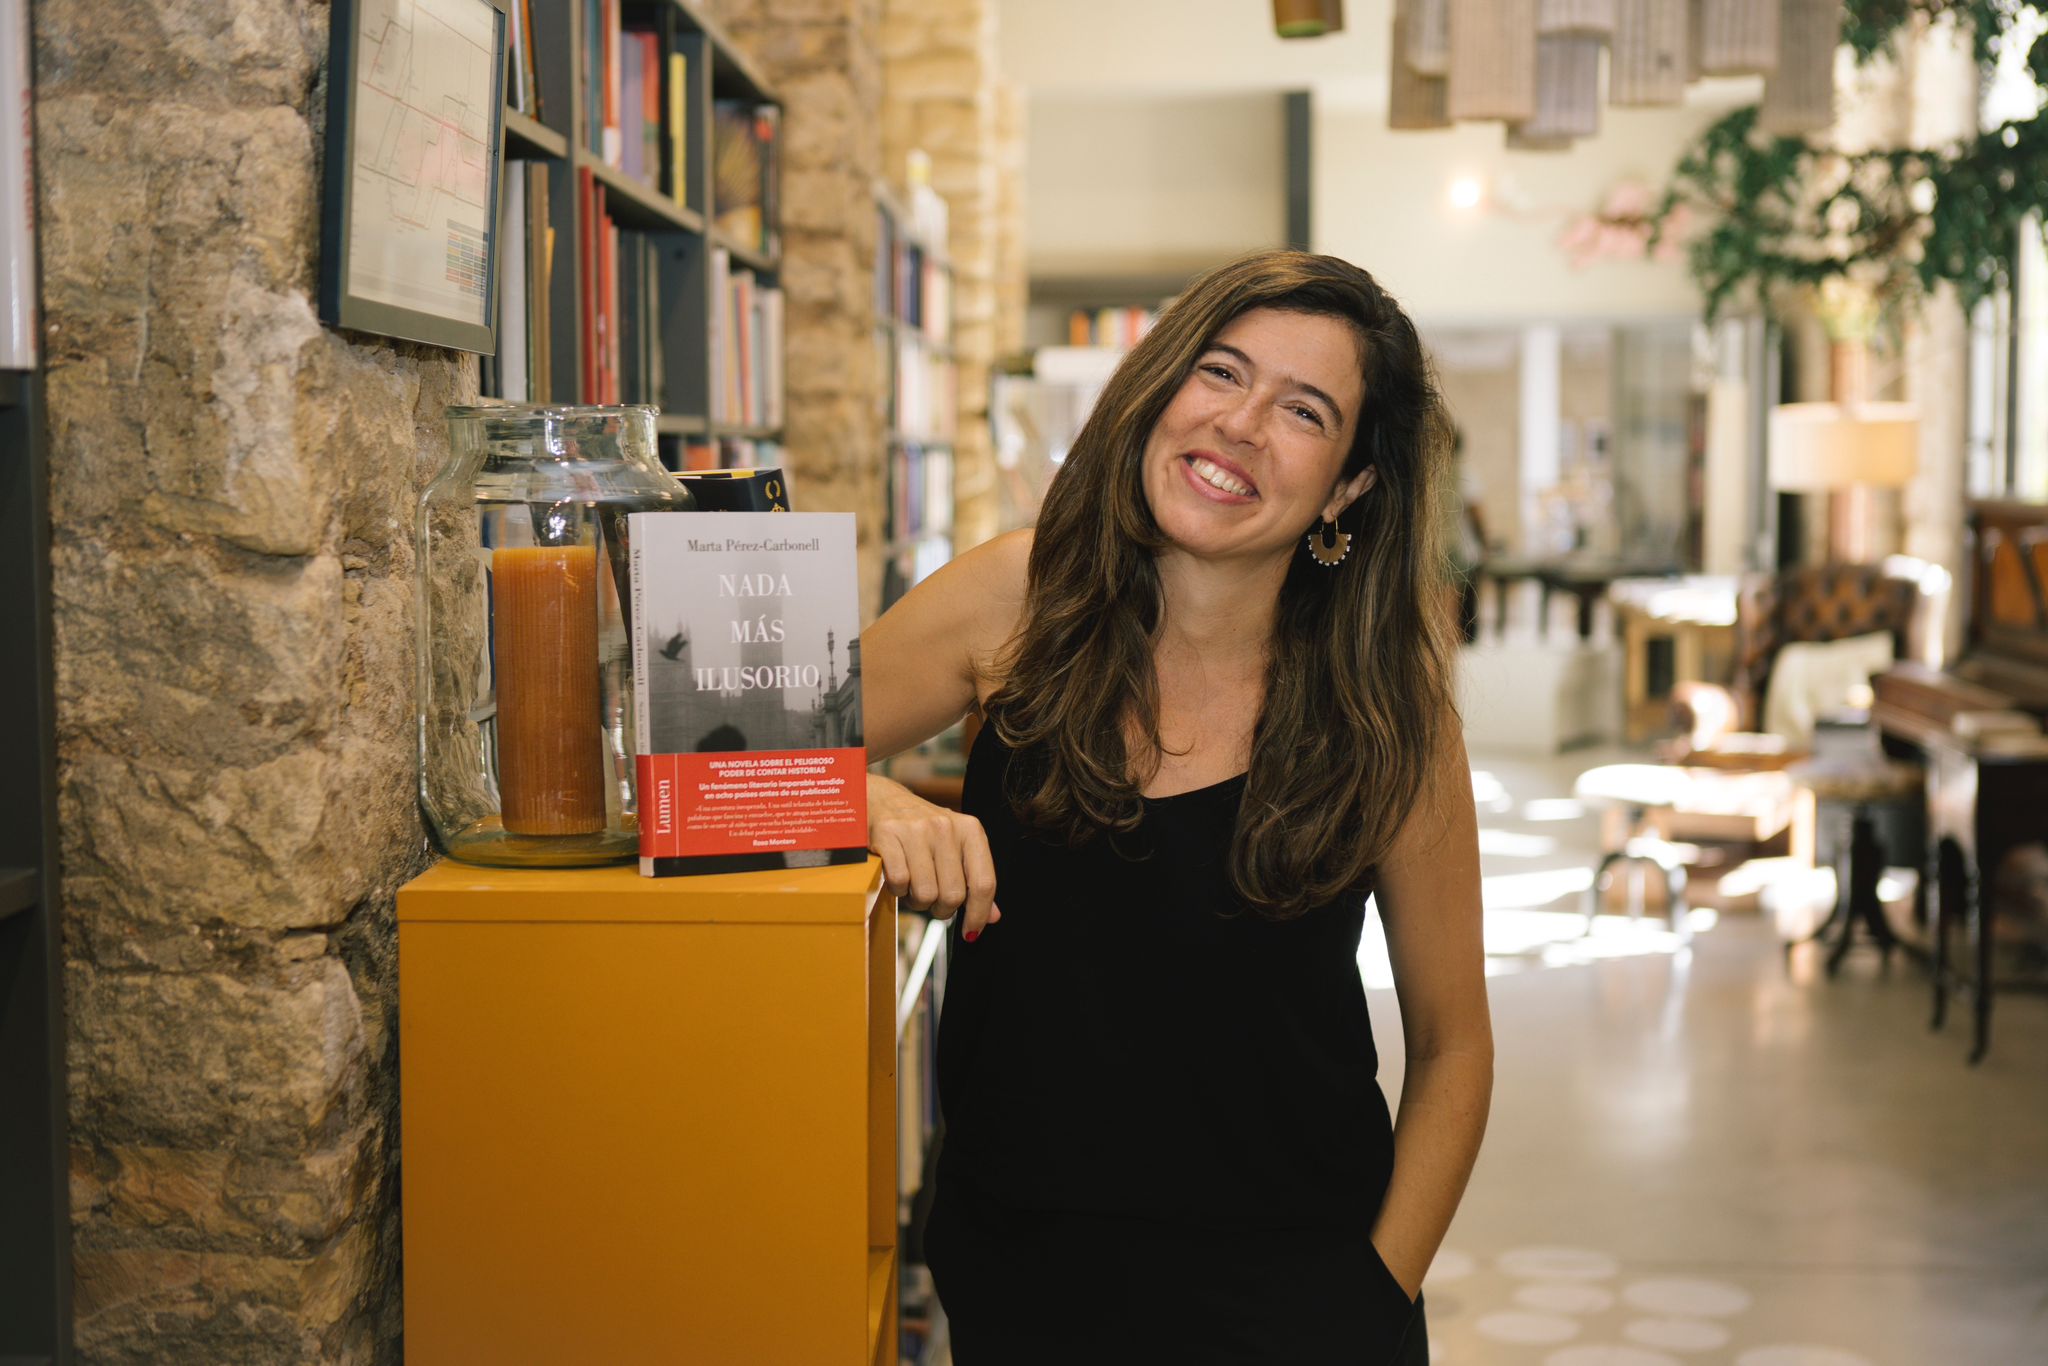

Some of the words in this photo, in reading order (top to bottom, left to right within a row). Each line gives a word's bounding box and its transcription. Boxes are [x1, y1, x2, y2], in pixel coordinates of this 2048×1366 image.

[687, 539, 722, 552] Marta
[726, 537, 820, 552] Pérez-Carbonell
[718, 573, 793, 597] NADA
[730, 613, 785, 643] MÁS
[695, 664, 820, 691] ILUSORIO
[709, 761, 727, 769] UNA
[728, 760, 759, 768] NOVELA
[760, 759, 784, 767] SOBRE
[785, 758, 793, 766] EL
[794, 757, 834, 766] PELIGROSO
[719, 769, 745, 778] PODER
[746, 769, 756, 777] DE
[757, 768, 787, 776] CONTAR
[788, 766, 826, 775] HISTORIAS
[699, 783, 710, 791] Un
[749, 780, 778, 789] literario
[715, 791, 734, 799] ocho
[759, 790, 779, 798] antes
[780, 789, 790, 797] de
[656, 779, 671, 834] Lumen
[752, 839, 769, 847] Rosa
[769, 838, 797, 846] Montero
